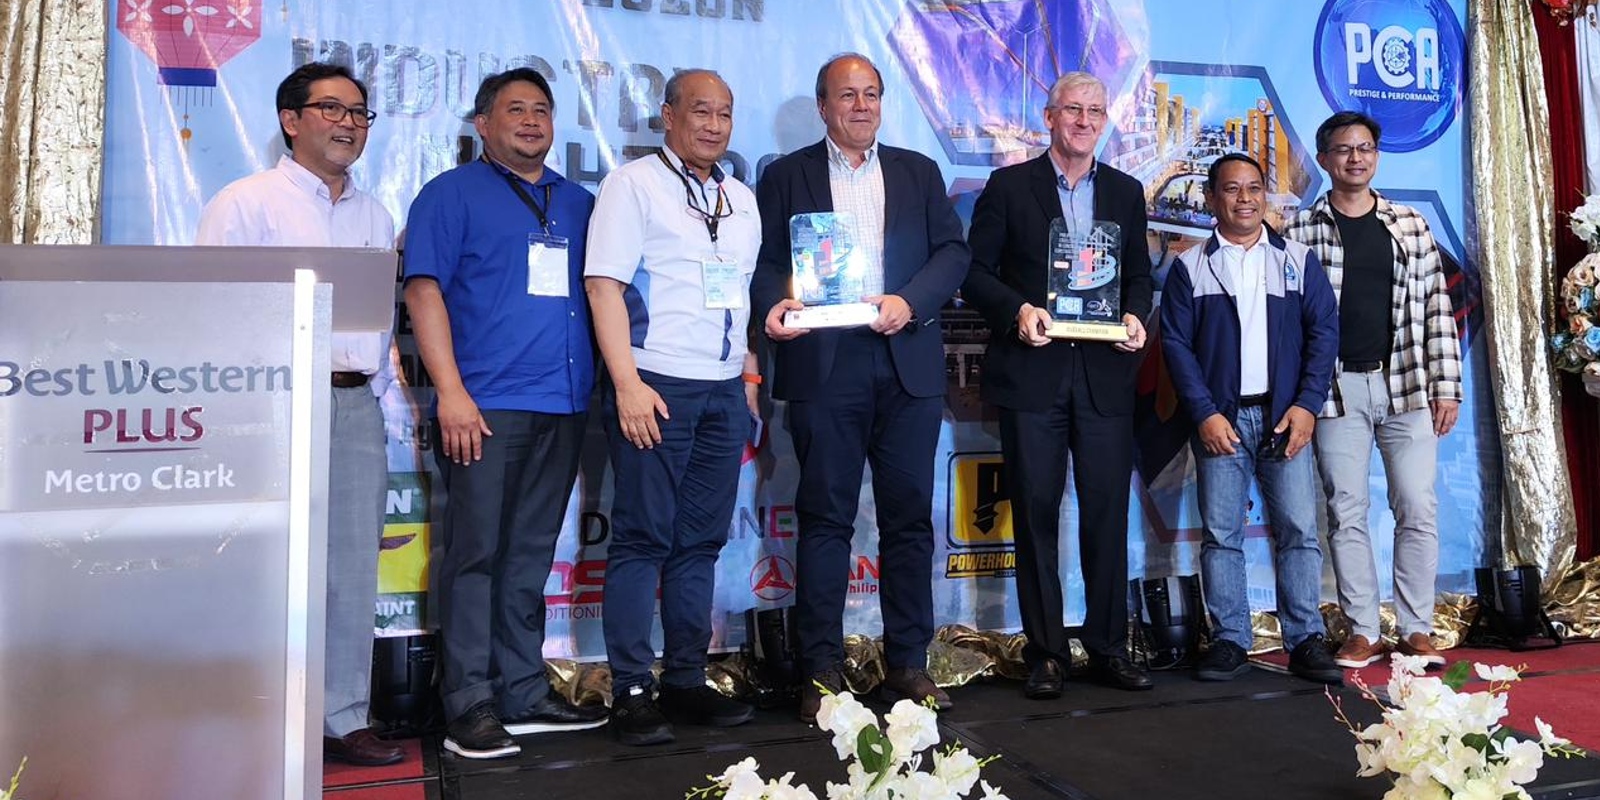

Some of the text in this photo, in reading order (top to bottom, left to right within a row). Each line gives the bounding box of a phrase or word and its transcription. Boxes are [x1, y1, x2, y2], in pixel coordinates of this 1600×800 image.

[1345, 22, 1440, 90] PCA
[1349, 89, 1440, 102] PRESTIGE & PERFORMANCE
[0, 359, 292, 397] Best Western
[83, 406, 205, 444] PLUS
[45, 463, 236, 494] Metro Clark
